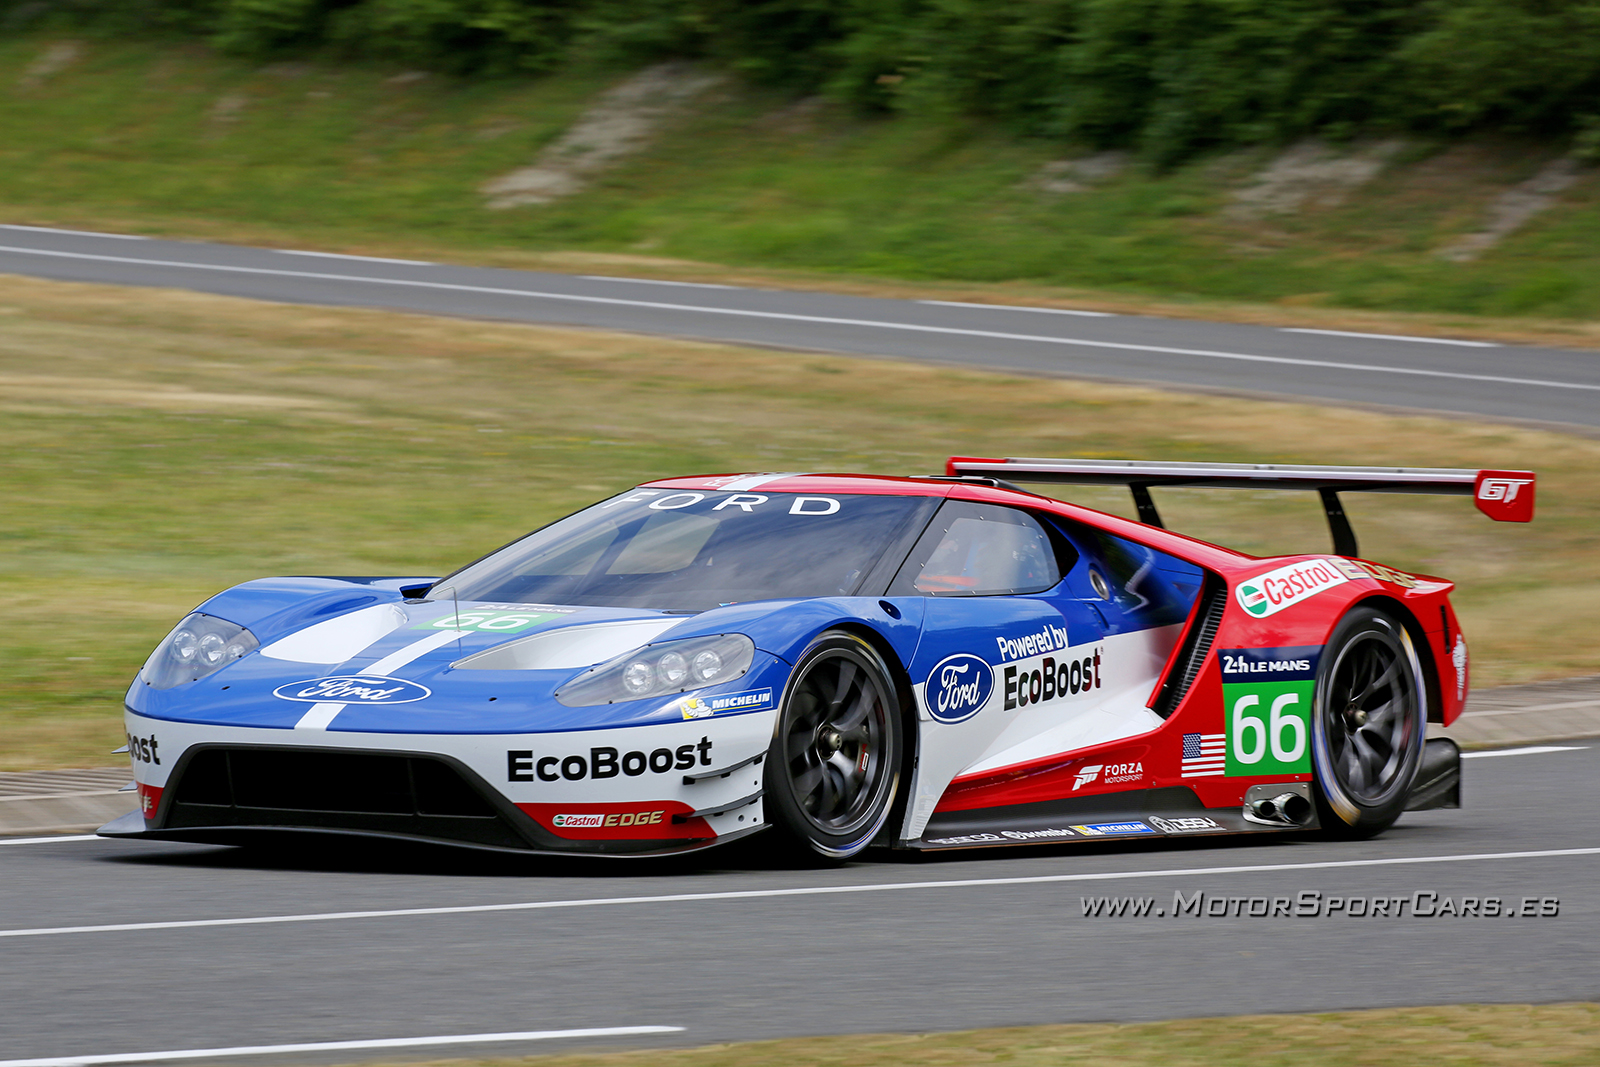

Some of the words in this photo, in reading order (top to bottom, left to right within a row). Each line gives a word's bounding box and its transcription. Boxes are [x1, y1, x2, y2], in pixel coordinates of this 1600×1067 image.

[1478, 477, 1534, 503] GT
[602, 491, 841, 515] FORD
[1264, 562, 1339, 605] Castrol
[432, 612, 541, 630] 66
[996, 624, 1053, 662] Powered
[1050, 623, 1069, 650] by
[1250, 662, 1268, 672] LE
[1268, 660, 1311, 672] MANS
[297, 677, 405, 701] Ford
[937, 663, 981, 713] Ford
[1003, 648, 1101, 711] EcoBoost
[712, 692, 771, 710] MICHELIN
[1232, 692, 1306, 764] 66
[507, 735, 713, 783] EcoBoost
[1105, 761, 1143, 777] FORZA
[1104, 773, 1143, 784] MOTORSPORT
[565, 814, 602, 827] Castrol
[604, 810, 666, 827] EDGE
[1096, 822, 1148, 833] MICHELIN
